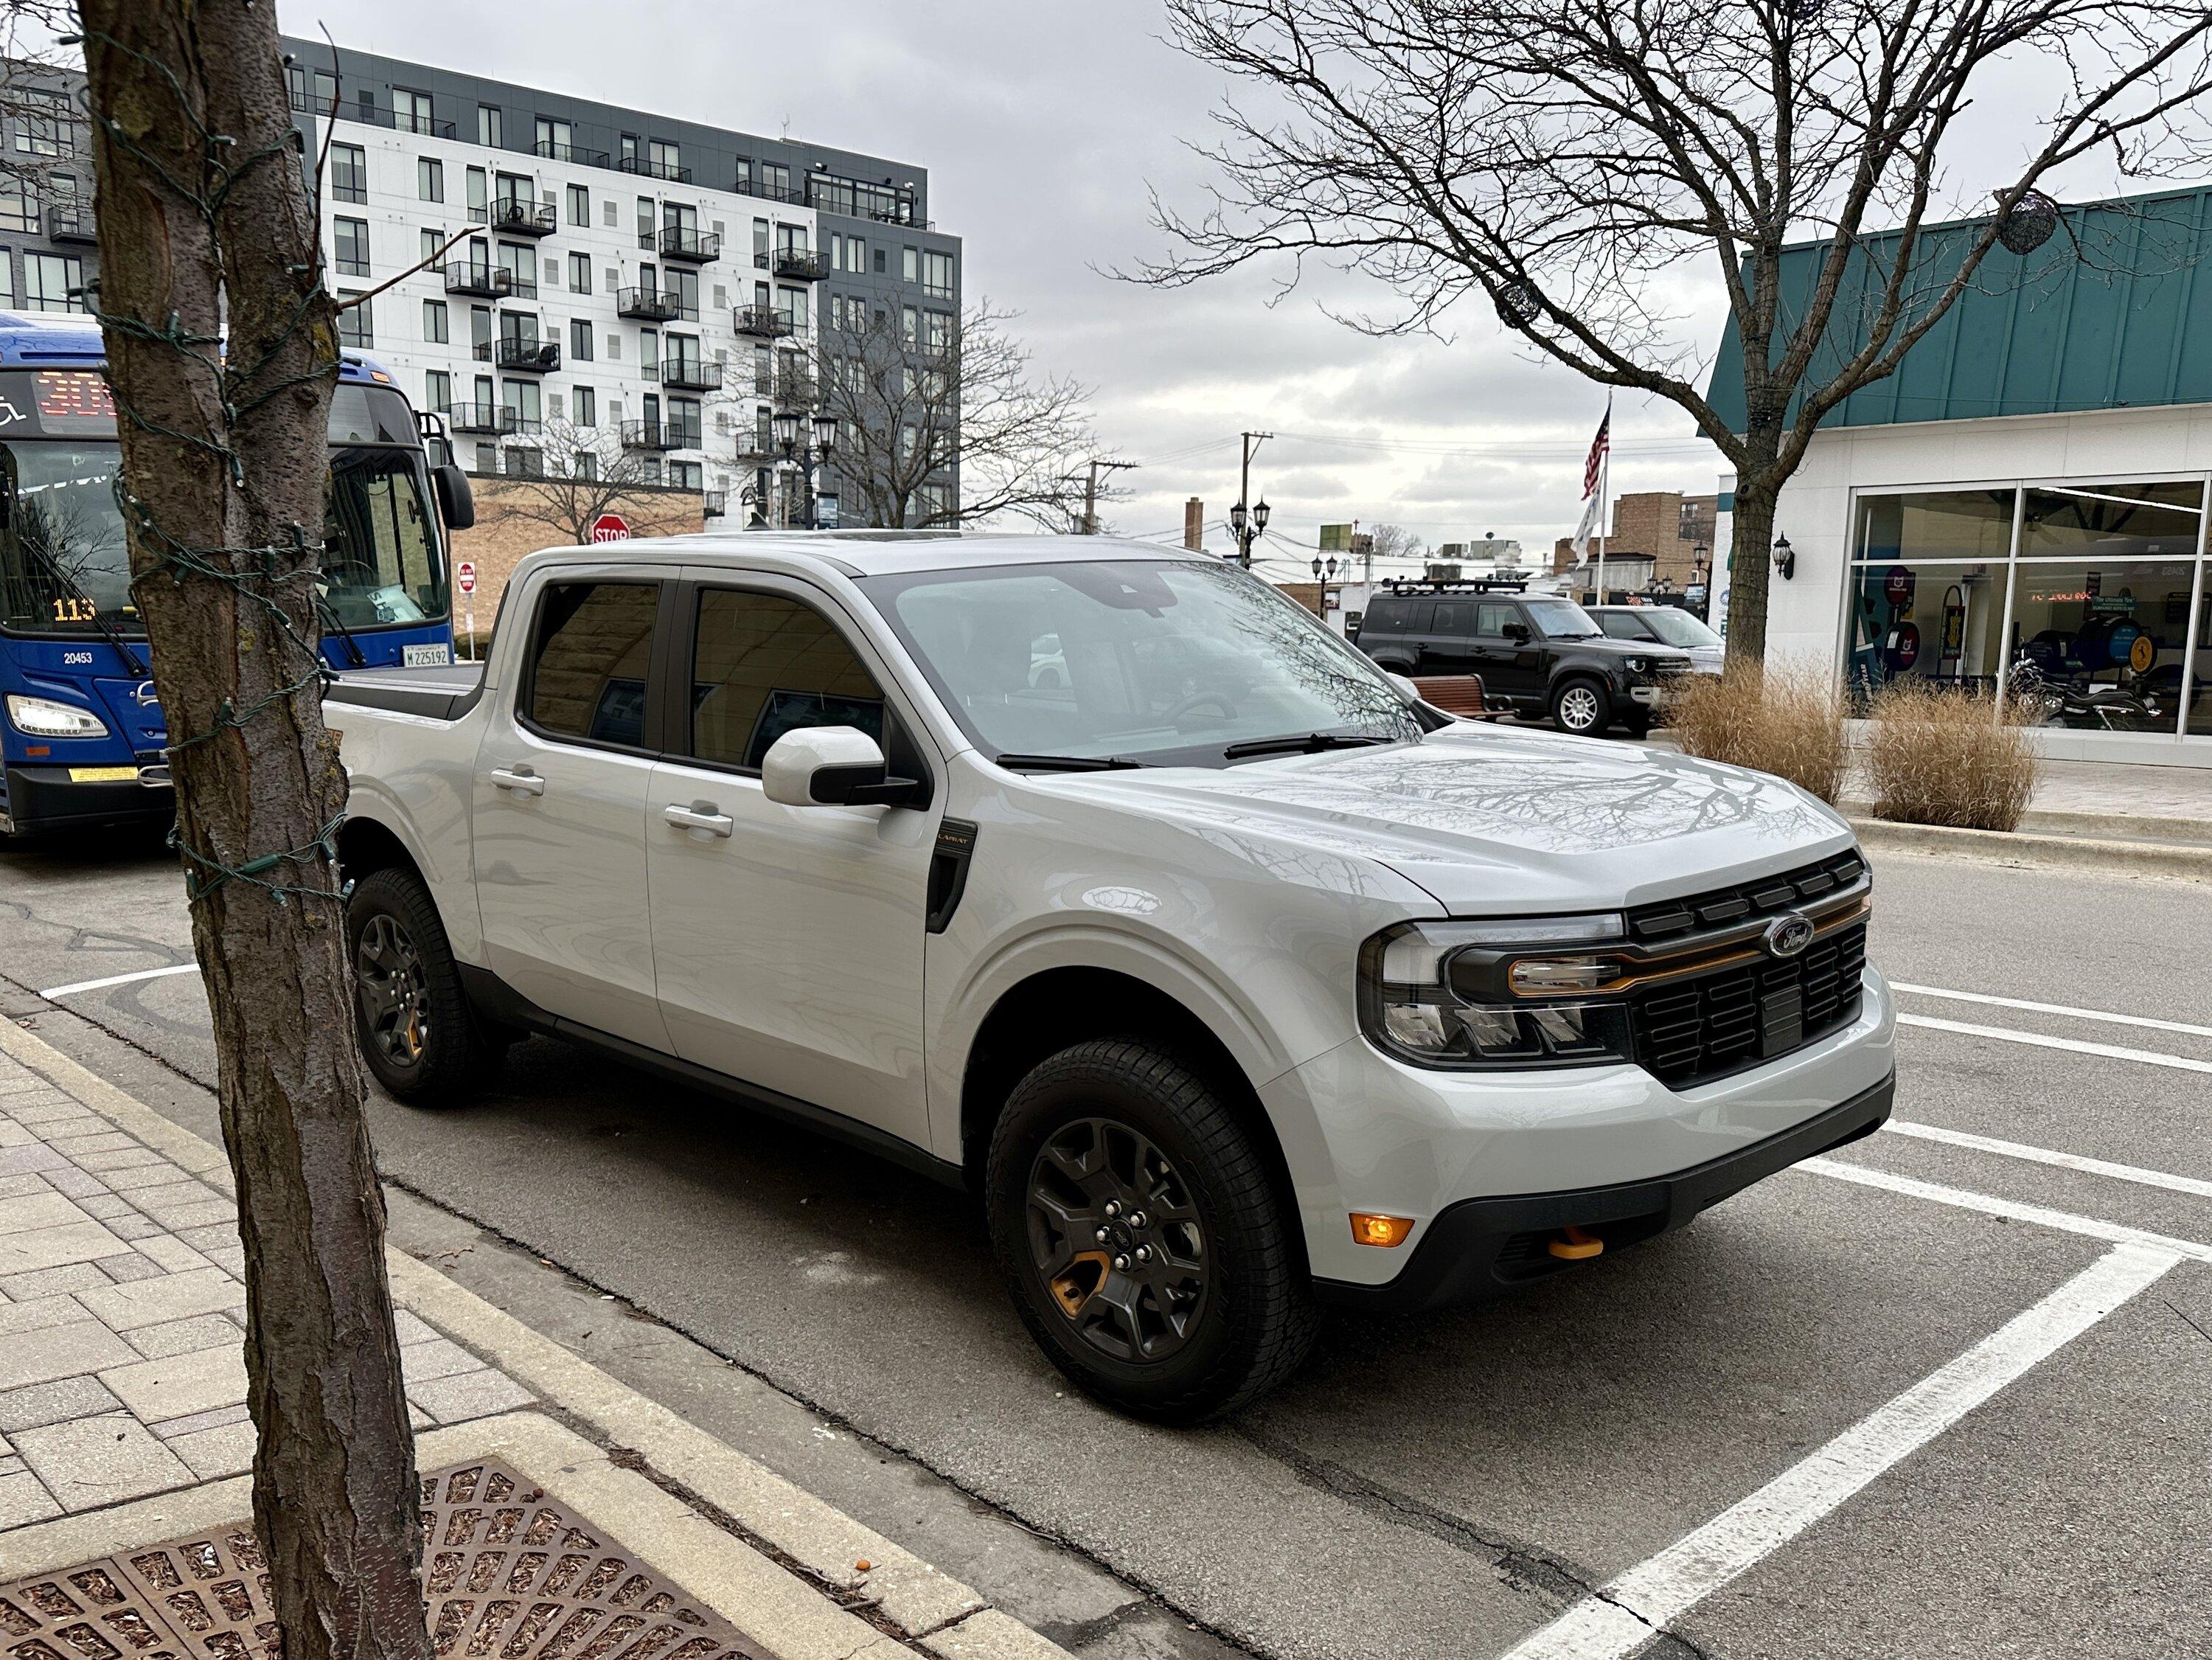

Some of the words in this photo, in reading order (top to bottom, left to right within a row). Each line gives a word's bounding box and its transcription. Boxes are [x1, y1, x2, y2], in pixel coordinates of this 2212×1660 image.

[596, 528, 627, 543] STOP
[64, 652, 93, 664] 20453
[415, 650, 447, 665] 225192
[938, 833, 969, 844] LARIAT
[1783, 925, 1807, 949] Ford
